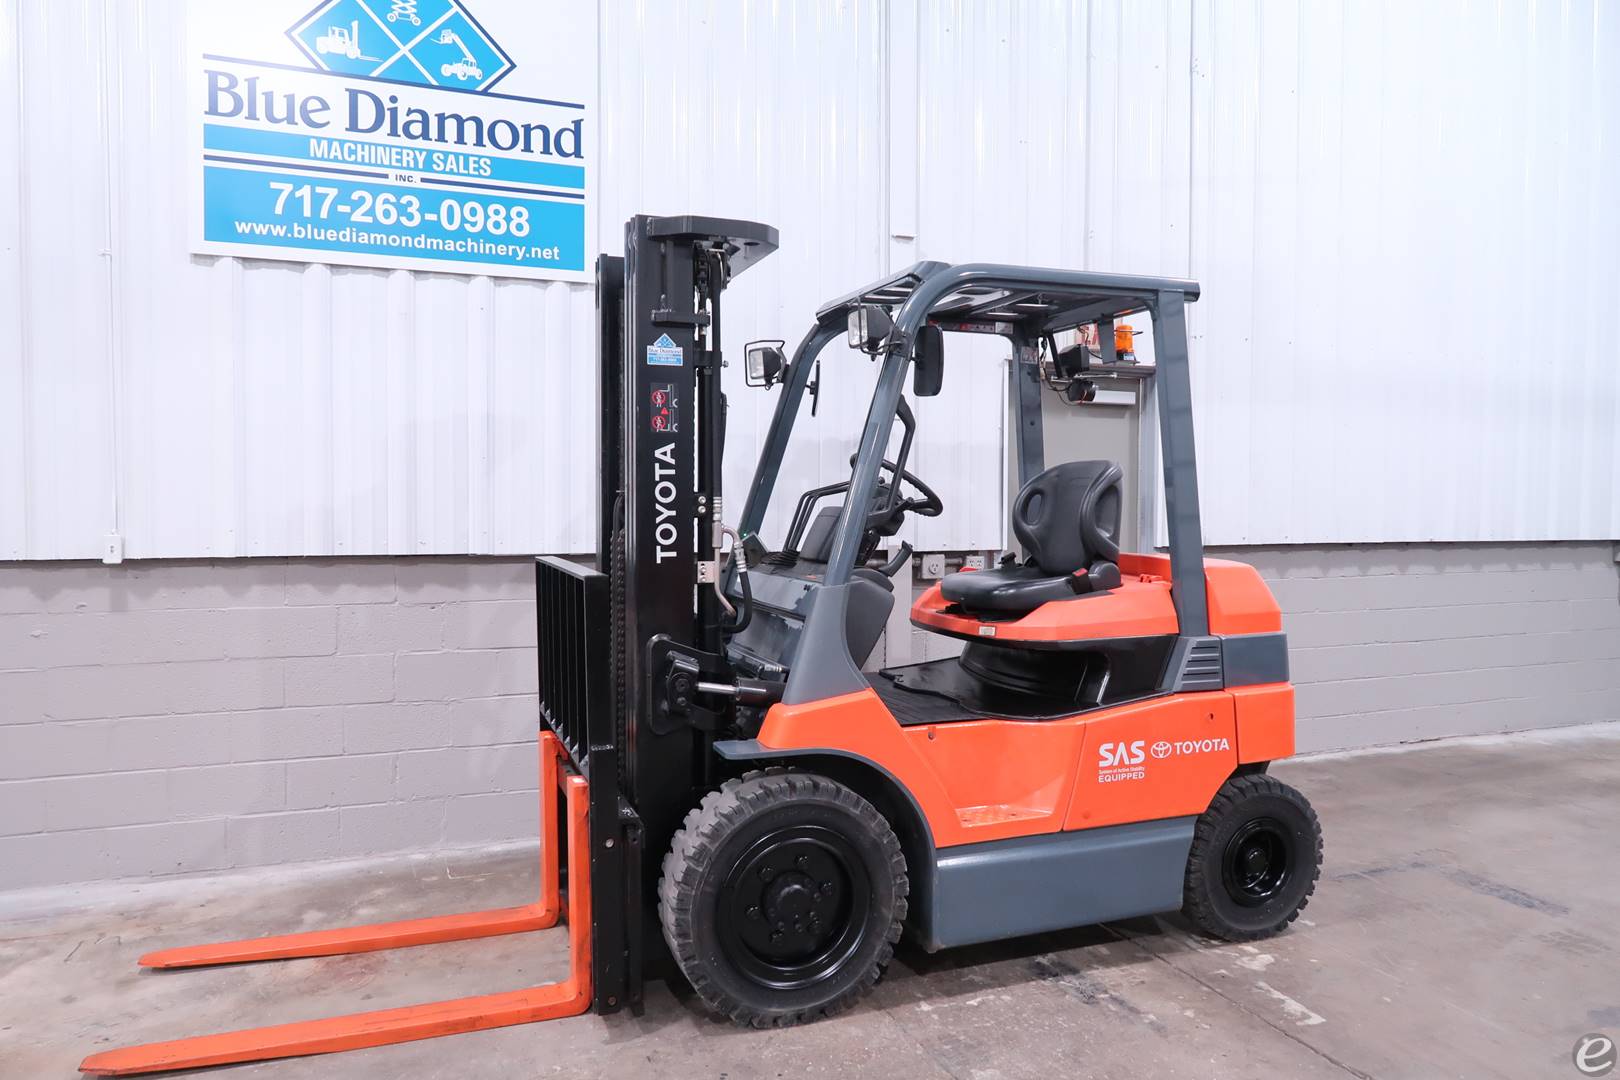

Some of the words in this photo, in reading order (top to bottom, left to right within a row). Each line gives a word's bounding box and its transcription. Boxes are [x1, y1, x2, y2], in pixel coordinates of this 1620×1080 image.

[203, 69, 332, 129] Blue
[344, 87, 585, 159] Diamond
[309, 138, 427, 170] MACHINERY
[432, 151, 493, 177] SALES
[395, 173, 417, 184] INC.
[269, 181, 531, 238] 717-263-0988
[234, 220, 561, 261] www.bluediamondmachinery.net
[655, 442, 678, 564] TOYOTA
[1098, 740, 1146, 768] SAS
[1174, 738, 1230, 755] TOYOTA
[1098, 771, 1145, 783] EQUIPPED
